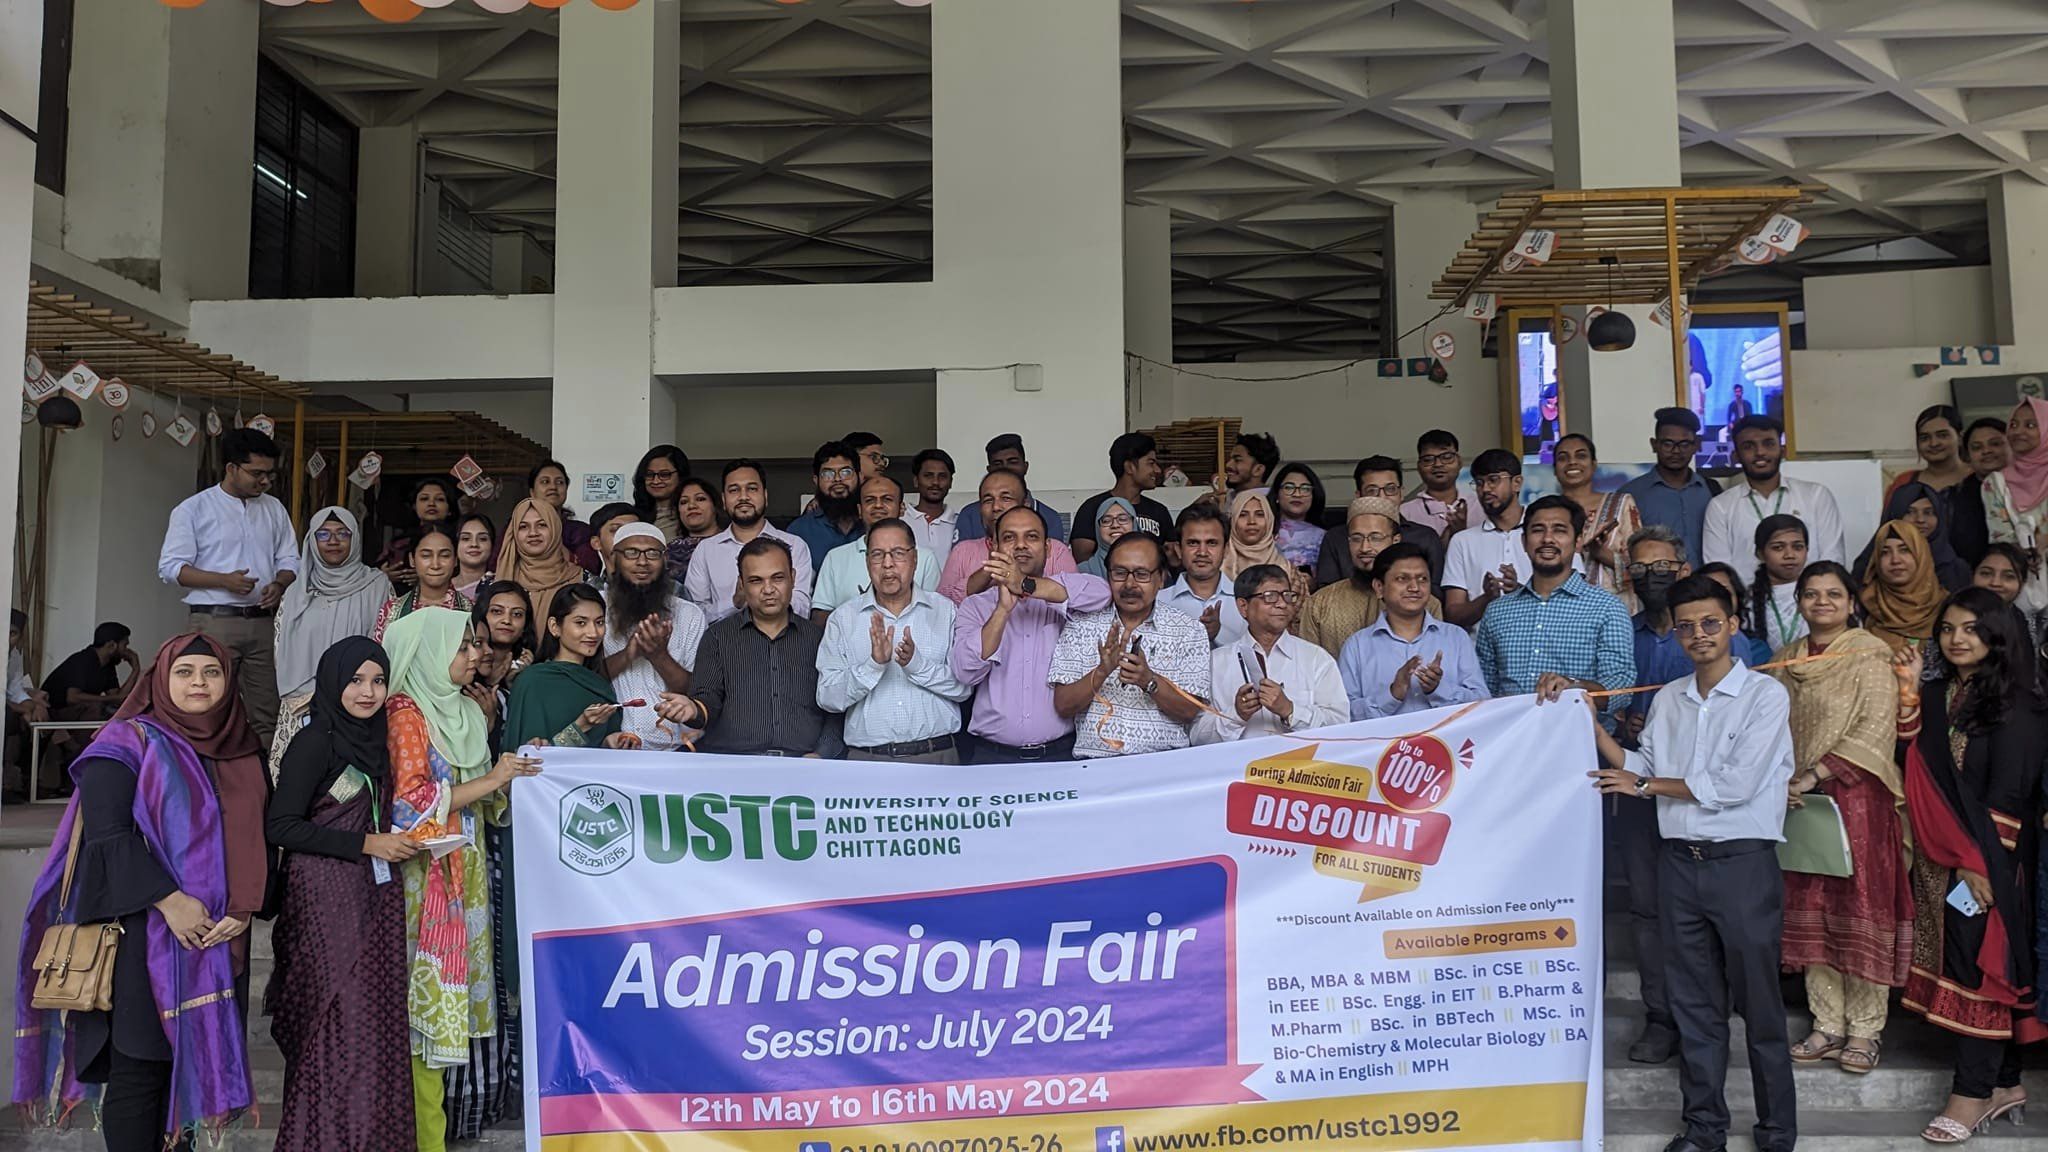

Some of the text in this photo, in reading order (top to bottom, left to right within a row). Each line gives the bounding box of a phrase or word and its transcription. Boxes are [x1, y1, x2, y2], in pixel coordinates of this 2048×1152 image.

[1399, 740, 1424, 757] Up to
[1250, 767, 1364, 793] During Admission Fair
[1382, 752, 1446, 803] 100%
[825, 789, 1079, 810] UNIVERSITY OF SCIENCE
[576, 818, 618, 836] USTC
[640, 792, 818, 864] USTC
[825, 810, 1015, 834] AND TECHNOLOGY
[1251, 794, 1421, 851] DISCOUNT
[826, 837, 961, 859] CHITTAGONG
[1315, 852, 1421, 882] FOR ALL STUDENTS
[1354, 908, 1413, 922] Available
[1416, 909, 1433, 918] on
[1435, 903, 1502, 917] Admission
[1505, 901, 1527, 913] Fee
[1395, 930, 1547, 950] Available Programs
[602, 912, 1197, 1009] Admission Fair
[1267, 959, 1580, 992] BBA, MBA & MBM BSc. in CSE BSc.
[1269, 981, 1583, 1014] in EEE BSc. Engg. in EIT B.Pharm &
[742, 1004, 1113, 1061] Session: July 2024
[1271, 1004, 1585, 1037] M.Pharm BSc. in BBTech MSc. in
[1273, 1028, 1588, 1060] Bio-Chemistry & Molecular Biology BA
[1275, 1058, 1449, 1084] & MA in English MPH
[681, 1077, 1109, 1126] 12th May to 16th May 2024
[1132, 1110, 1460, 1151] www.fb.com/ustc1992
